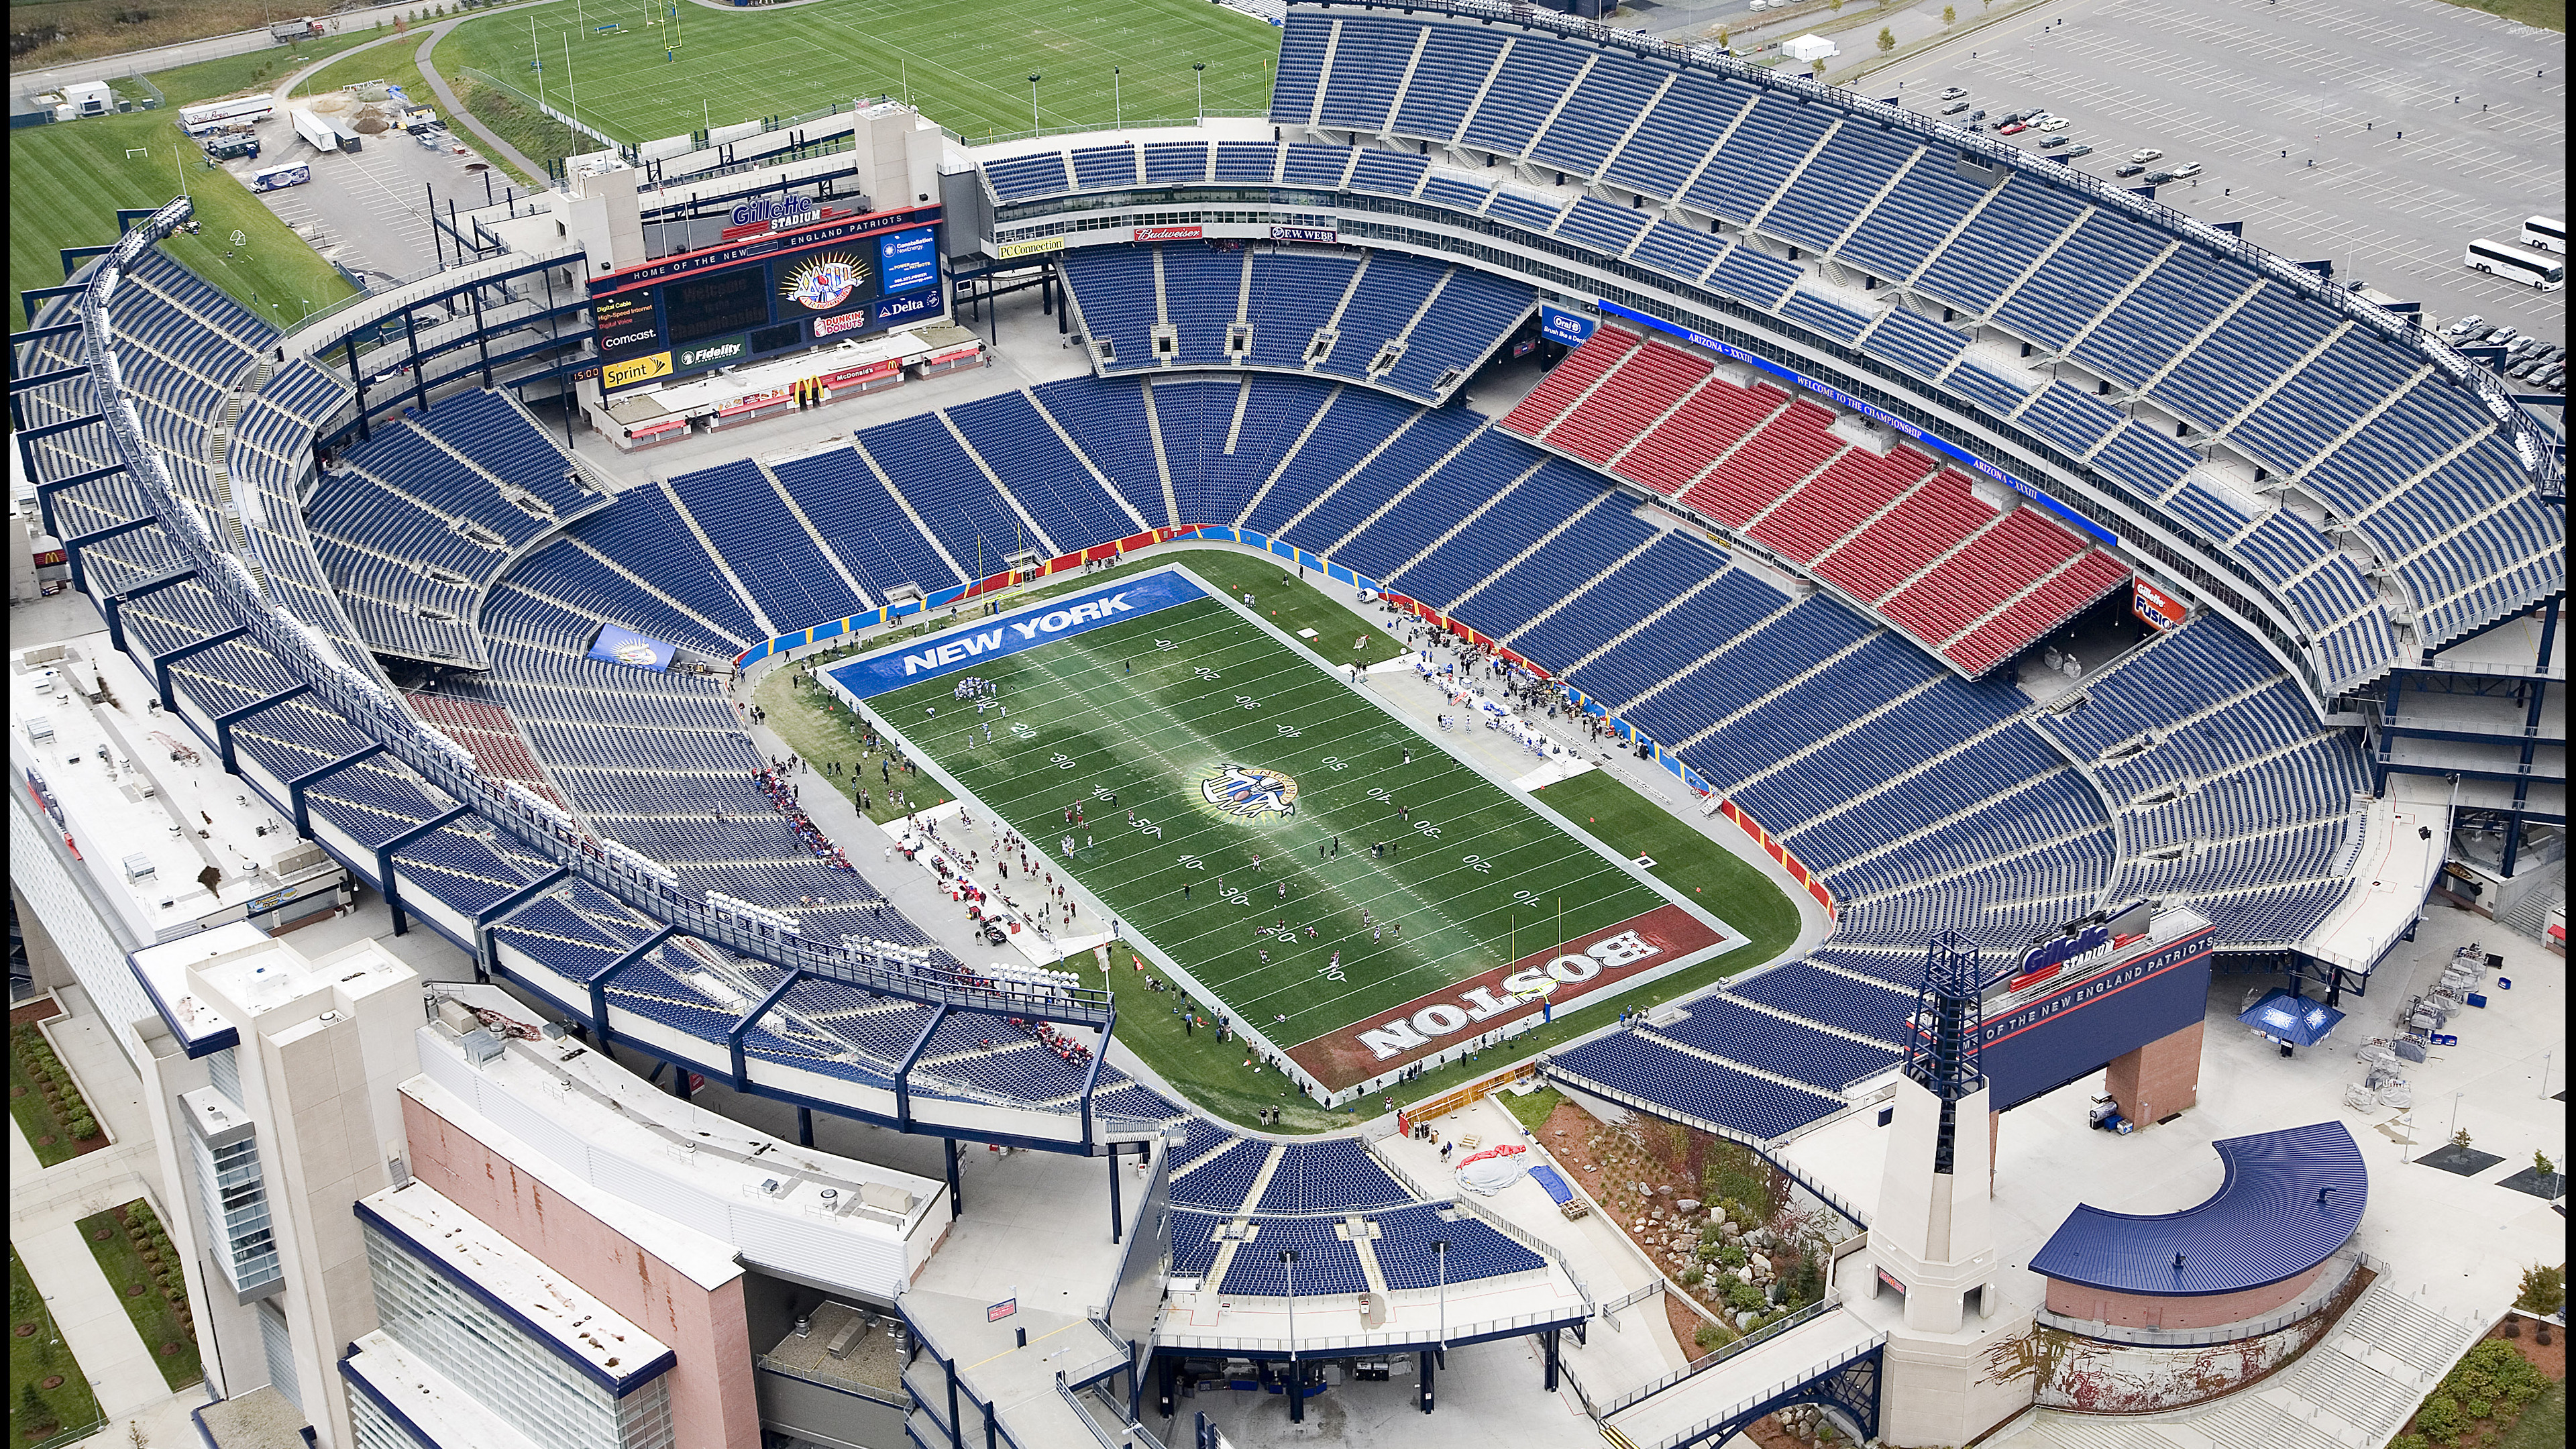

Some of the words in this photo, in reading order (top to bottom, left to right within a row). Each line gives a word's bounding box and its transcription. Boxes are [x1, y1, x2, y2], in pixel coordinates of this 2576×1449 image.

[731, 193, 812, 226] Gillette
[771, 209, 821, 229] STADIUM
[1135, 228, 1200, 240] Budweiser
[1285, 229, 1303, 238] F.W.
[1304, 230, 1334, 240] WEBB
[634, 268, 665, 280] HOME
[674, 262, 688, 271] OF
[694, 256, 716, 266] THE
[724, 249, 747, 260] NEW
[792, 228, 843, 246] ENGLAND
[850, 215, 902, 233] PATRIOTS
[1000, 246, 1013, 257] PC
[1014, 240, 1062, 255] Connection
[597, 303, 614, 313] Digital
[615, 301, 632, 309] Cable
[598, 309, 630, 321] High-Speed
[631, 305, 652, 315] Internet
[892, 301, 924, 315] Delta
[599, 320, 617, 329] Digital
[619, 318, 633, 326] Voice
[826, 310, 864, 326] DUNKIN'
[826, 320, 863, 334] DONUTS
[1544, 326, 1558, 335] Brush
[1559, 331, 1568, 339] like
[1688, 333, 1723, 352] ARIZONA
[695, 343, 741, 362] Fidelity
[608, 364, 647, 384] Sprint
[837, 368, 873, 381] McDonald's
[1798, 376, 1834, 398] WELCOME
[1835, 392, 1846, 403] TO
[1847, 397, 1862, 411] THE
[1864, 406, 1922, 439] CHAMPIONSHIP
[1973, 460, 2007, 484] ARIZONA
[2137, 584, 2164, 608] Gillette
[903, 628, 1006, 676] NEW
[1010, 592, 1134, 640] YORK
[1157, 639, 1179, 653] 10
[1196, 666, 1221, 682] 20
[1236, 695, 1261, 711] 30
[1010, 723, 1036, 739] 20
[1278, 724, 1302, 738] 40
[1050, 753, 1076, 769] 30
[1322, 756, 1348, 771] 50
[1244, 769, 1297, 803] ARIZONA
[1091, 787, 1114, 802] 40
[1366, 788, 1392, 802] 40
[1132, 818, 1159, 835] 50
[1413, 820, 1442, 837] 30
[1177, 854, 1203, 869] 40
[1462, 855, 1493, 872] 20
[1220, 887, 1248, 906] 30
[1513, 890, 1541, 906] 10
[2021, 924, 2108, 973] Gillette
[2061, 939, 2114, 972] STADIUM
[1354, 928, 1664, 1062] BOSTON
[1986, 1024, 2004, 1040] OF
[2009, 1011, 2035, 1029] THE
[2041, 996, 2071, 1016] NEW
[2076, 967, 2142, 1002] ENGLAND
[2147, 936, 2214, 971] PATRIOTS
